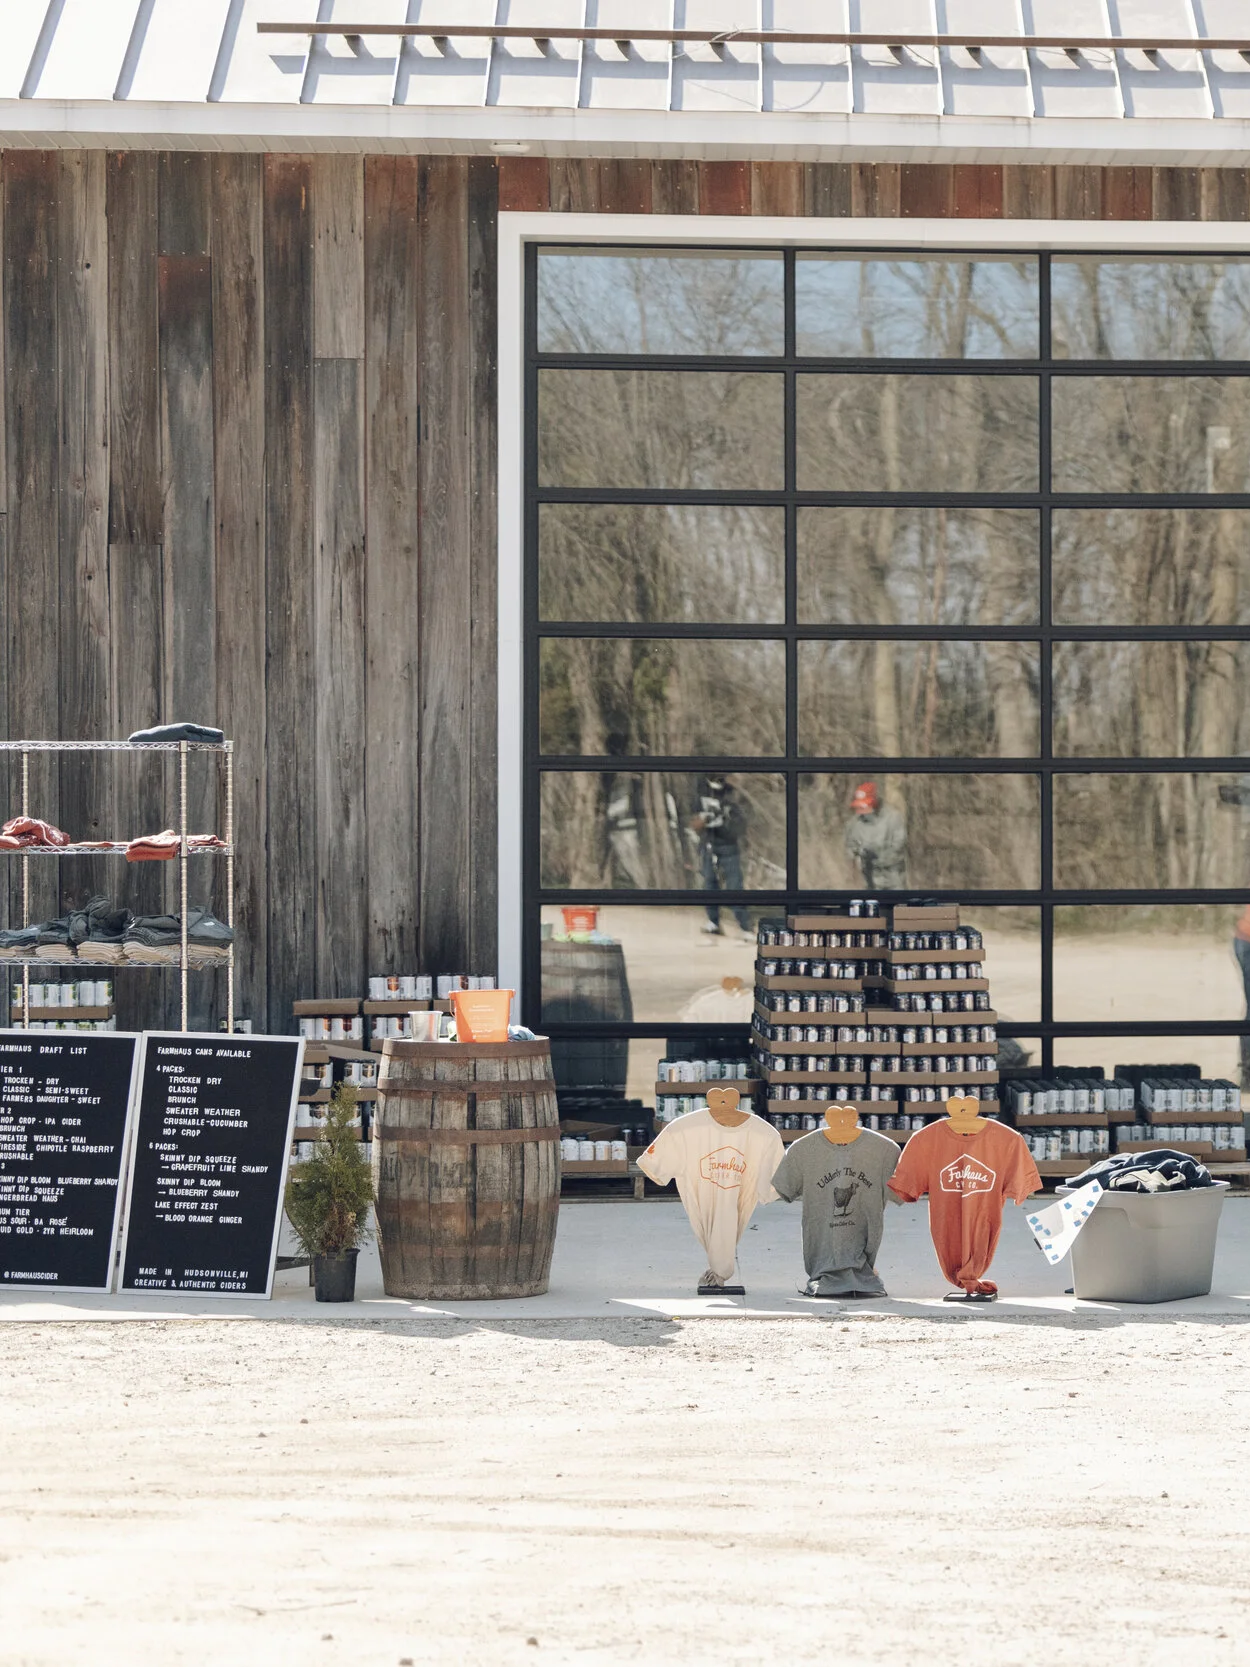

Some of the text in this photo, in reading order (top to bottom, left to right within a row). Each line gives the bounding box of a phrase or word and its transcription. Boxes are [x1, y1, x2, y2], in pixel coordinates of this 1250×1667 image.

[40, 1046, 63, 1054] DRAFT
[70, 1047, 88, 1055] LIST
[157, 1047, 251, 1058] FARMHAUS CANS AVAILABLE
[1, 1065, 13, 1073] IER
[169, 1076, 201, 1084] TROCKEN
[2, 1095, 34, 1103] FARMERS
[77, 1097, 101, 1105] SWEET
[168, 1096, 197, 1104] BRUNCH
[165, 1107, 241, 1116] SWEATER WEATHER
[162, 1128, 201, 1137] HOP CROP
[33, 1135, 64, 1143] WEATHER
[36, 1144, 68, 1152] CHIPOTLE
[72, 1145, 115, 1153] RASPBERRY
[155, 1143, 179, 1151] PACKS:
[0, 1152, 34, 1160] RUSHABLE
[160, 1154, 237, 1164] SKINNY DIP SQUEEZE
[171, 1163, 215, 1172] GRAPEFRUIT
[220, 1165, 237, 1173] LIME
[843, 1167, 857, 1177] The
[857, 1171, 873, 1189] Best
[948, 1165, 988, 1182] Fahaus
[0, 1175, 15, 1183] INNY
[30, 1176, 51, 1184] BLOOM
[57, 1177, 91, 1185] BLUEBERRY
[94, 1178, 118, 1186] SHANDY
[157, 1178, 221, 1187] SKINNY DIP BLOOM
[0, 1185, 64, 1195] INNY DIP SQUEEZE
[168, 1188, 208, 1197] BLUEBERRY
[155, 1201, 171, 1209] LAKE
[15, 1208, 30, 1216] TIER
[10, 1217, 27, 1225] SOUR
[165, 1214, 243, 1224] BLOOD ORANGE GINGER
[16, 1226, 34, 1234] GOLD
[42, 1227, 55, 1235] 2YR
[60, 1228, 94, 1236] HEIRLOOM
[138, 1267, 157, 1275] MADE
[165, 1268, 173, 1276] IN
[134, 1279, 167, 1287] CREATIVE
[179, 1280, 216, 1289] AUTHENTIC
[220, 1281, 247, 1290] CIDERS
